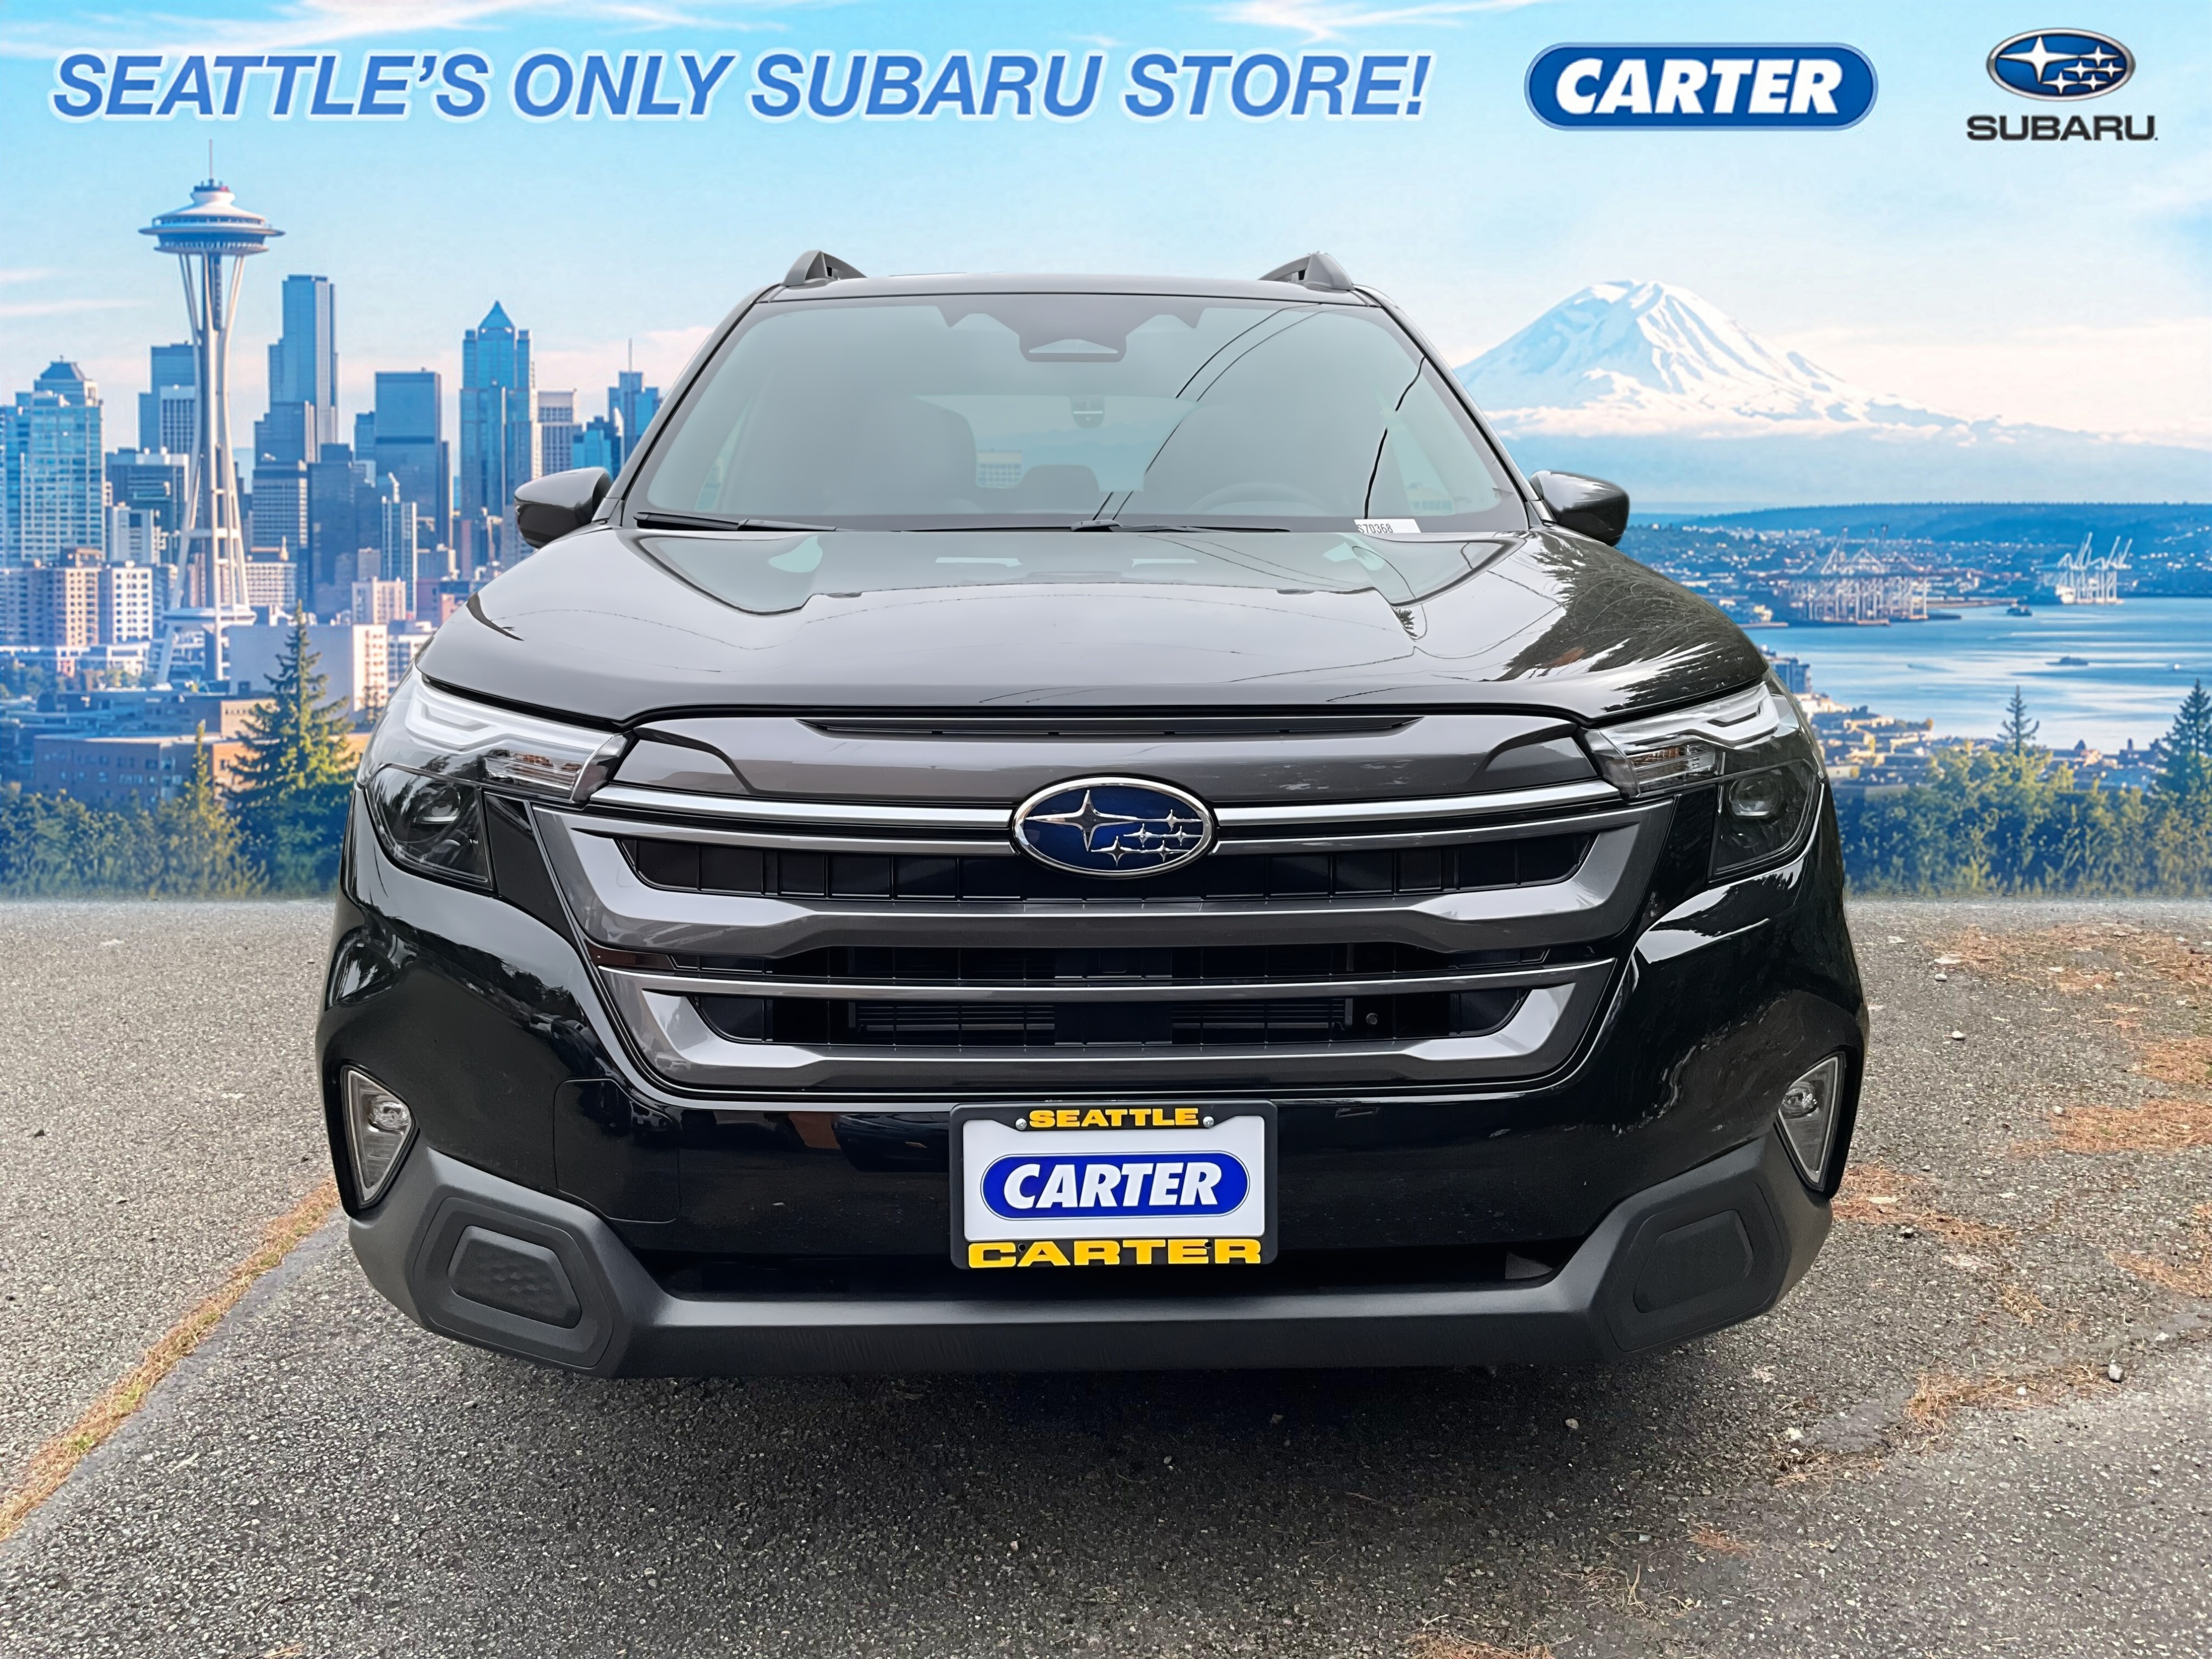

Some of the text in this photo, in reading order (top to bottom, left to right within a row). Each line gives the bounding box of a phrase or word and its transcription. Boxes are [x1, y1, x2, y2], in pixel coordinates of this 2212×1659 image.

[1029, 1108, 1199, 1128] SEATTLE
[1003, 1162, 1222, 1209] CARTER
[968, 1239, 1261, 1269] CARTER
